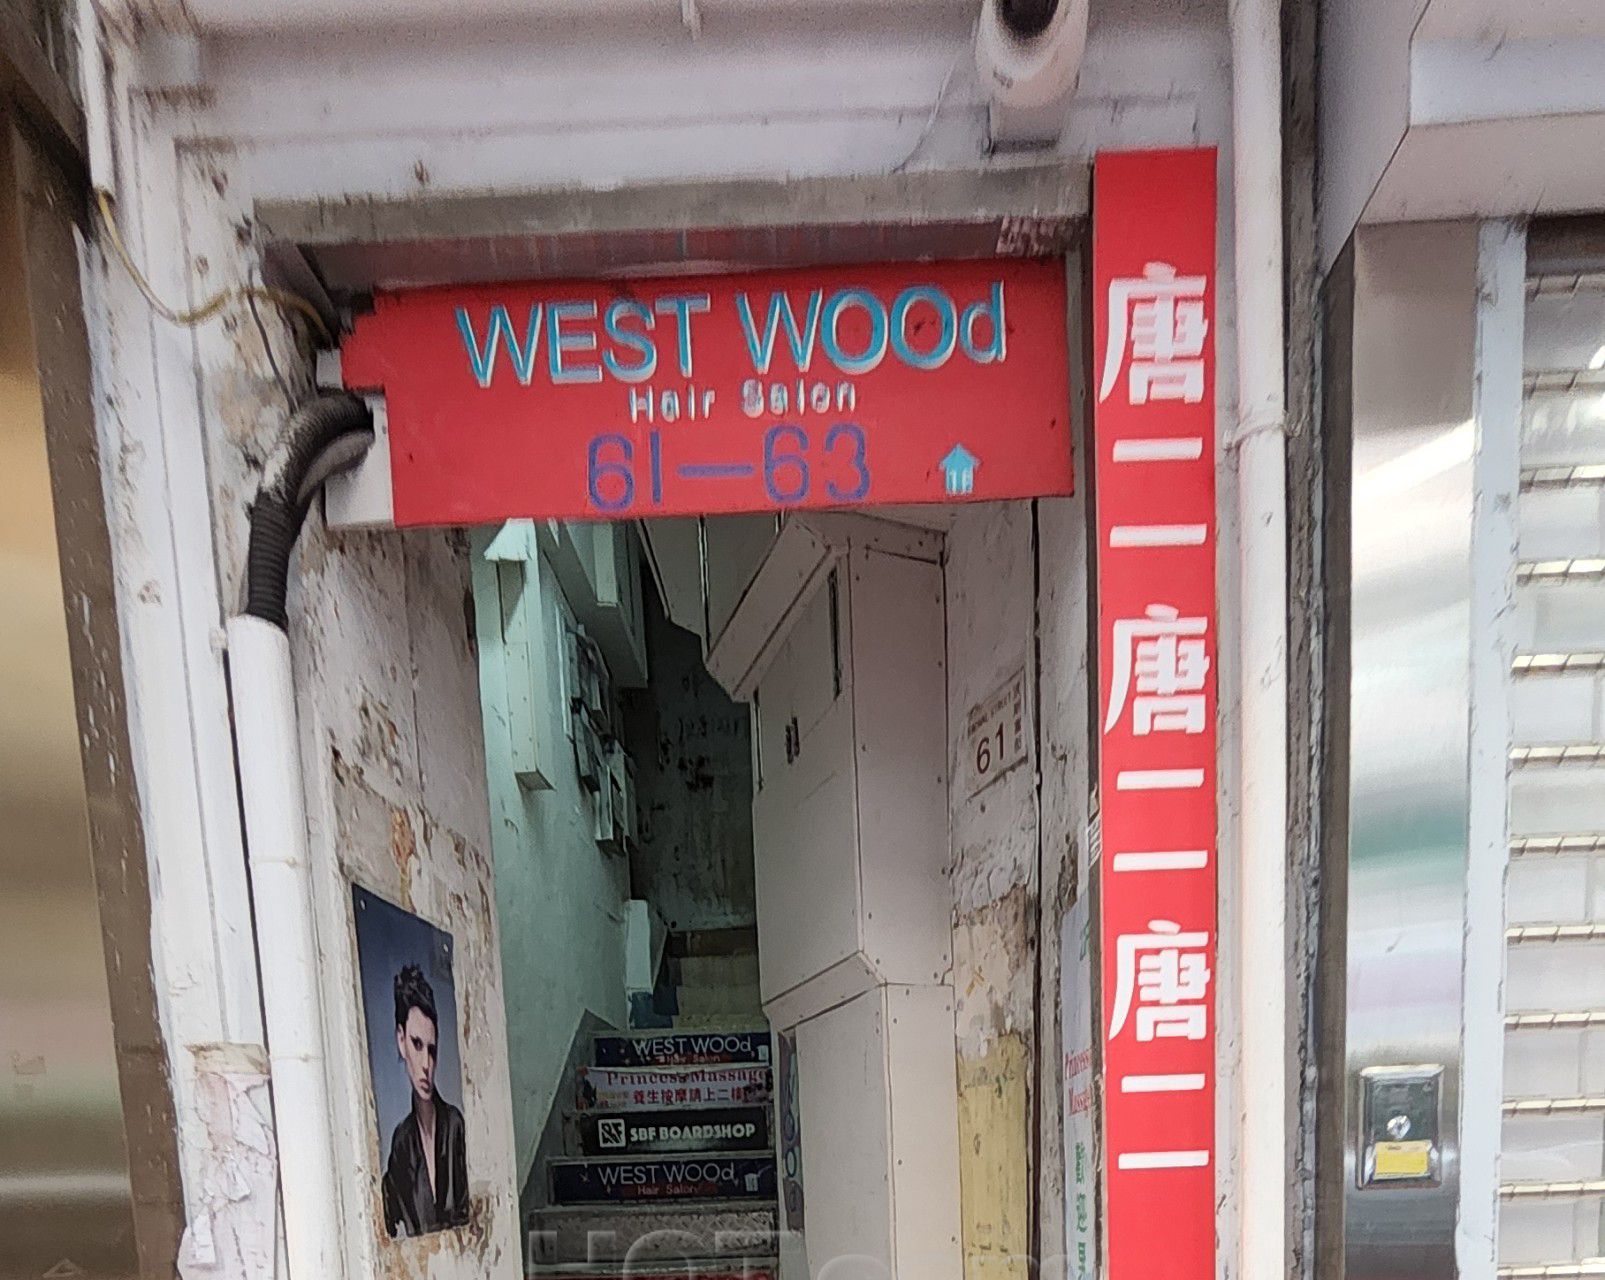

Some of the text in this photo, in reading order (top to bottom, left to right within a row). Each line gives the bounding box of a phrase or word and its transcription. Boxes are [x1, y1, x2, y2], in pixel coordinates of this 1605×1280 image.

[456, 294, 710, 388] WEST
[629, 378, 856, 423] Hair Salon
[976, 722, 1003, 774] 61
[632, 1037, 687, 1056] WEST
[630, 1127, 656, 1142] SBF
[660, 1123, 755, 1141] BOARDSHOP
[598, 1165, 659, 1186] WEST
[638, 1184, 696, 1196] Hair Salon
